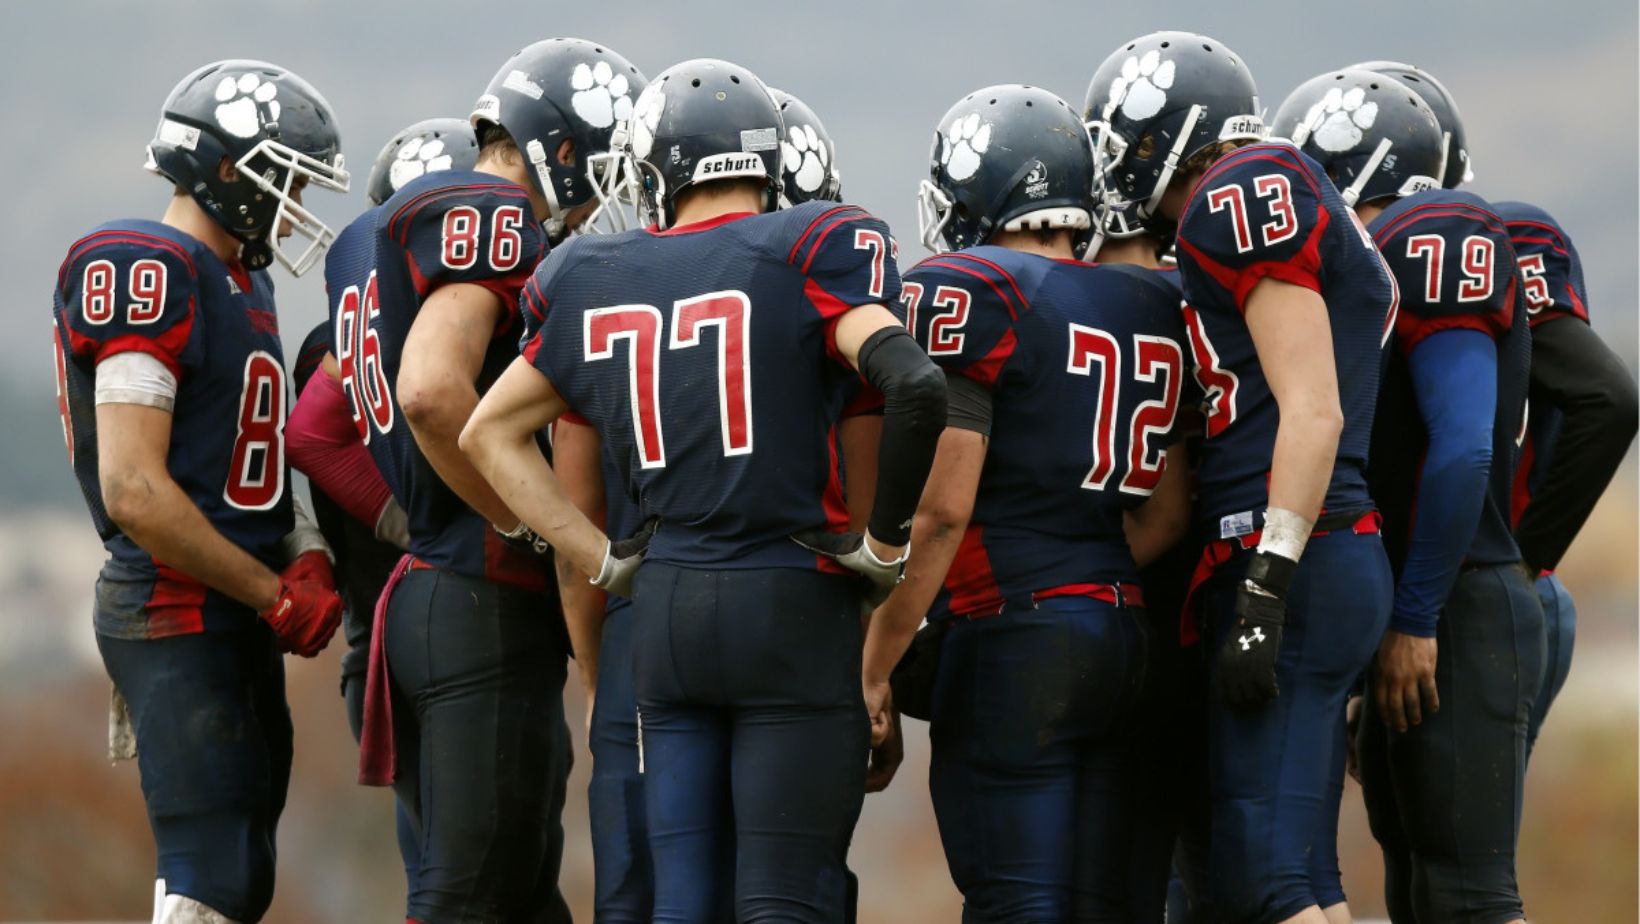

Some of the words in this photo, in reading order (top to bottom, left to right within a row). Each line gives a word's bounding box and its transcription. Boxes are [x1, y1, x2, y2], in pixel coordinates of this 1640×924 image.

[703, 157, 757, 174] schutt
[441, 205, 523, 271] 86
[1207, 173, 1298, 253] 73
[82, 259, 167, 325] 89
[854, 229, 899, 298] 7
[1406, 234, 1495, 302] 79
[899, 281, 972, 356] 72
[336, 268, 394, 446] 86
[583, 289, 753, 469] 77
[223, 350, 286, 511] 8
[1066, 322, 1184, 496] 72
